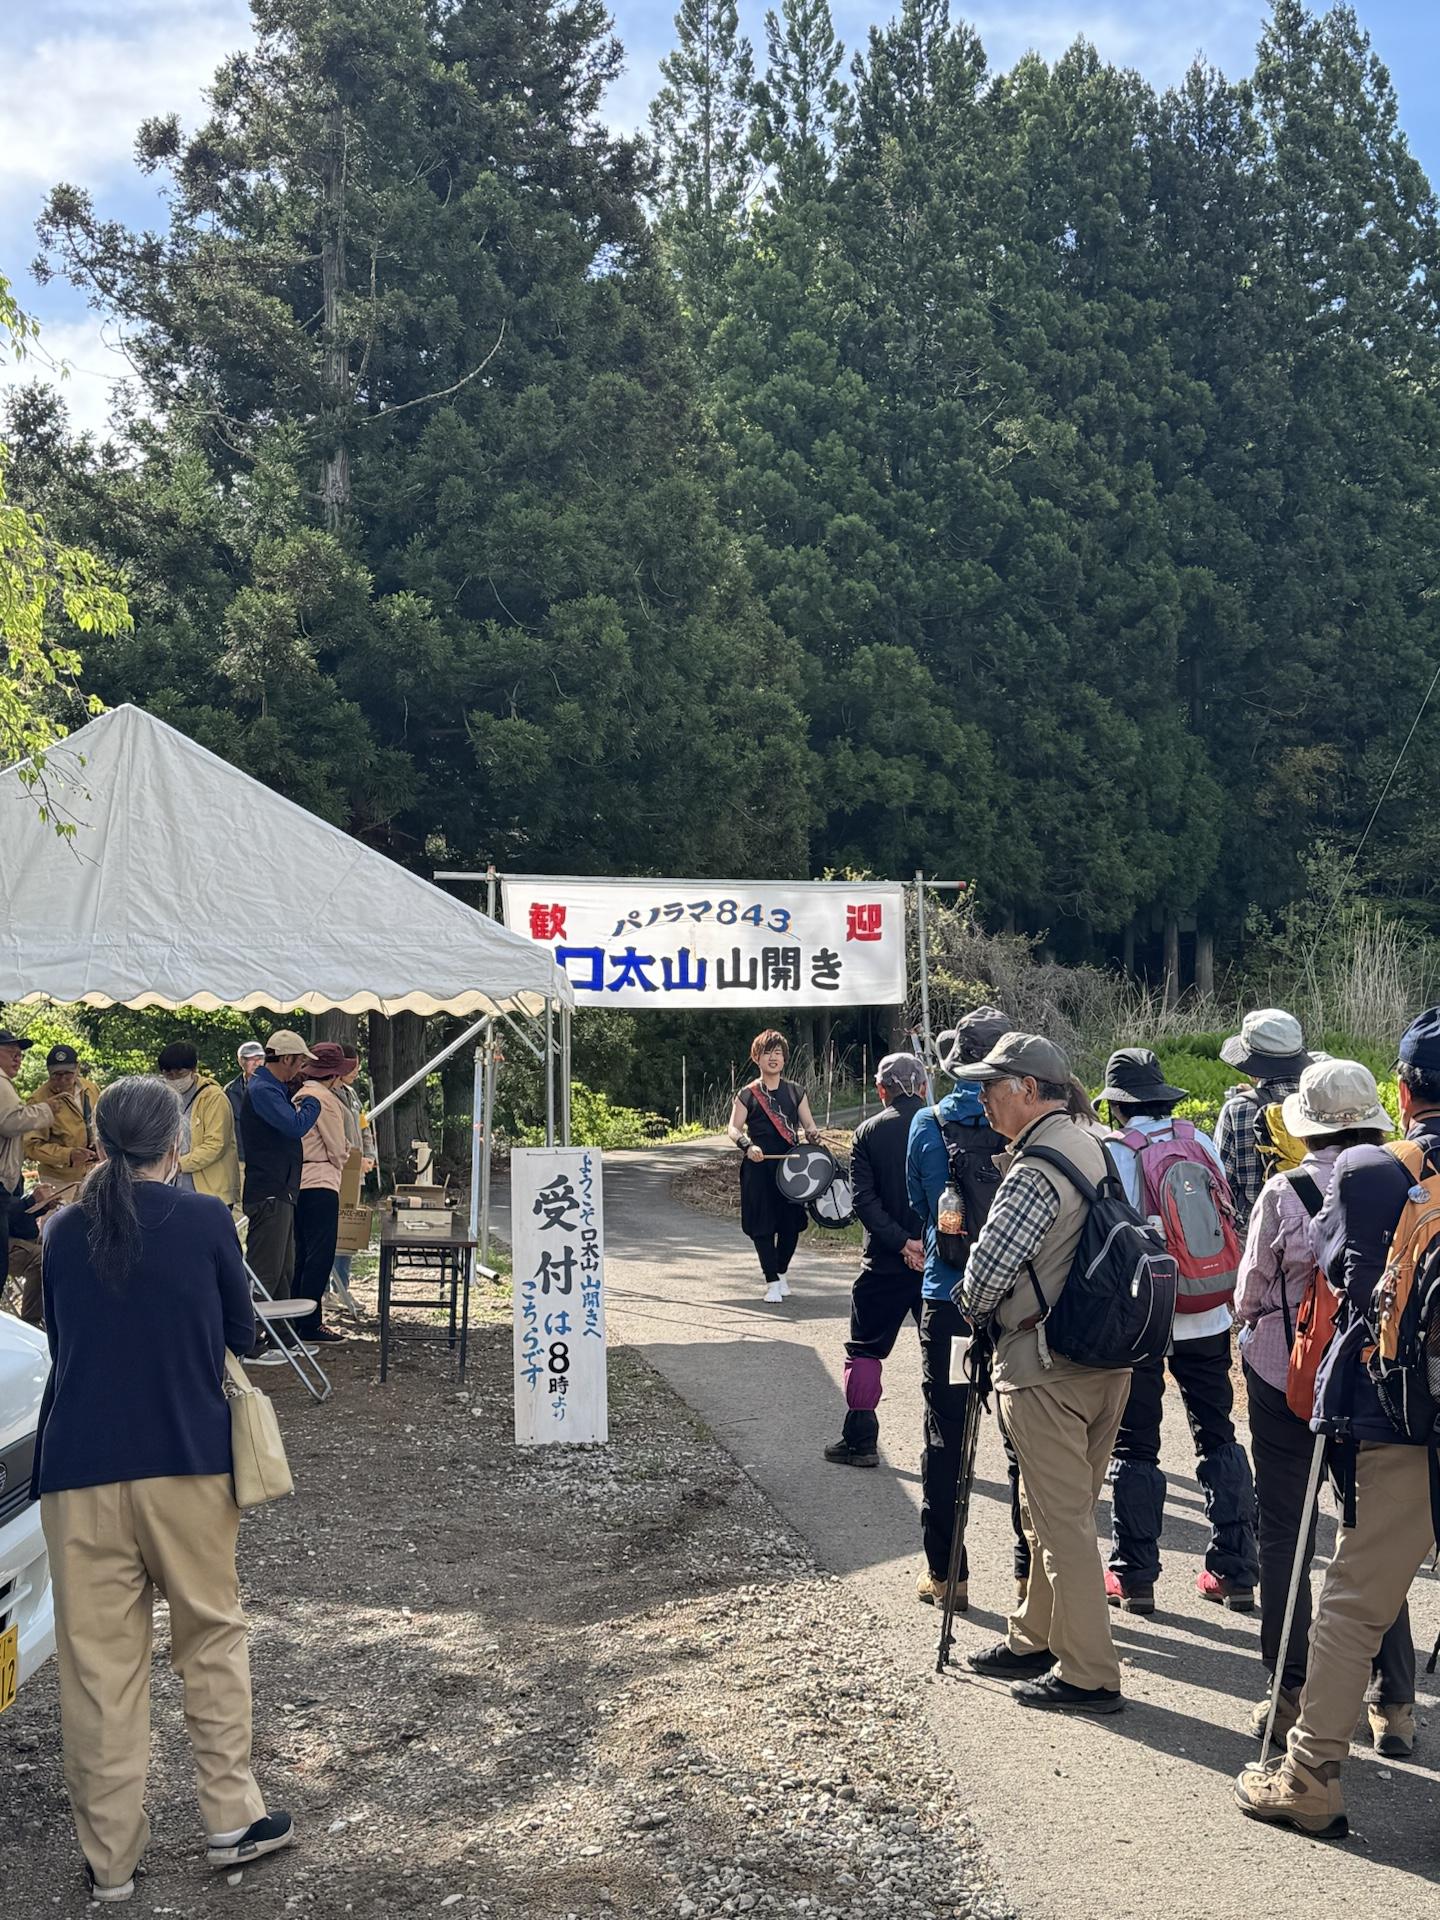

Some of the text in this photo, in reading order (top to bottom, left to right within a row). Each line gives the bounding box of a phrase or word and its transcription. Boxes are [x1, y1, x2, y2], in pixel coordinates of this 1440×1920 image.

[529, 902, 567, 941] 歓
[846, 903, 882, 941] 迎
[520, 1280, 545, 1393] こちらです
